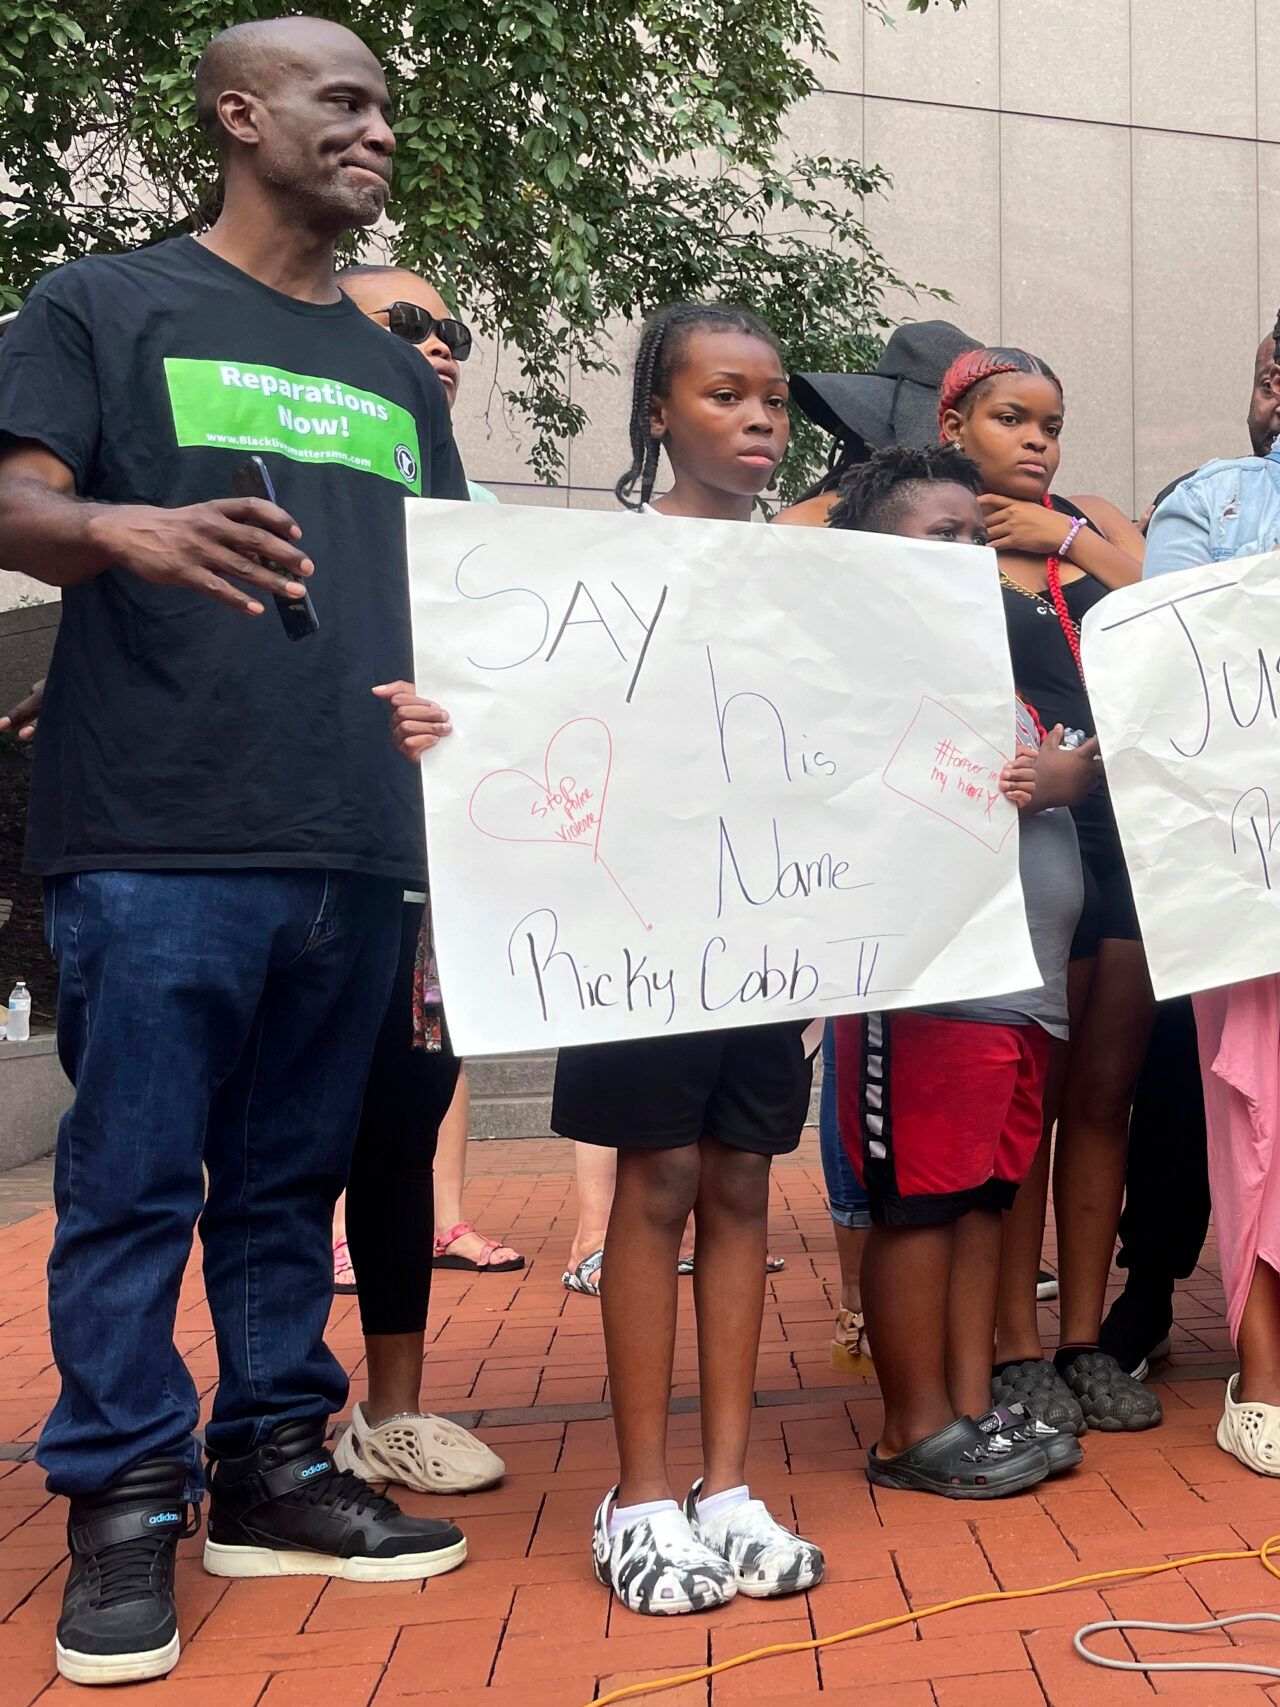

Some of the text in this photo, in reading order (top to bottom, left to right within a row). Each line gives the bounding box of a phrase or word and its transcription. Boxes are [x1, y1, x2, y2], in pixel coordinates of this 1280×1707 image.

[219, 365, 389, 421] Reparations
[278, 404, 350, 438] Now!
[454, 543, 668, 703] SAY
[706, 645, 837, 783] his
[716, 816, 874, 918] Name
[508, 908, 915, 1024] Ricky Cobb II
[301, 1460, 329, 1478] adidas
[149, 1511, 179, 1525] adidas
